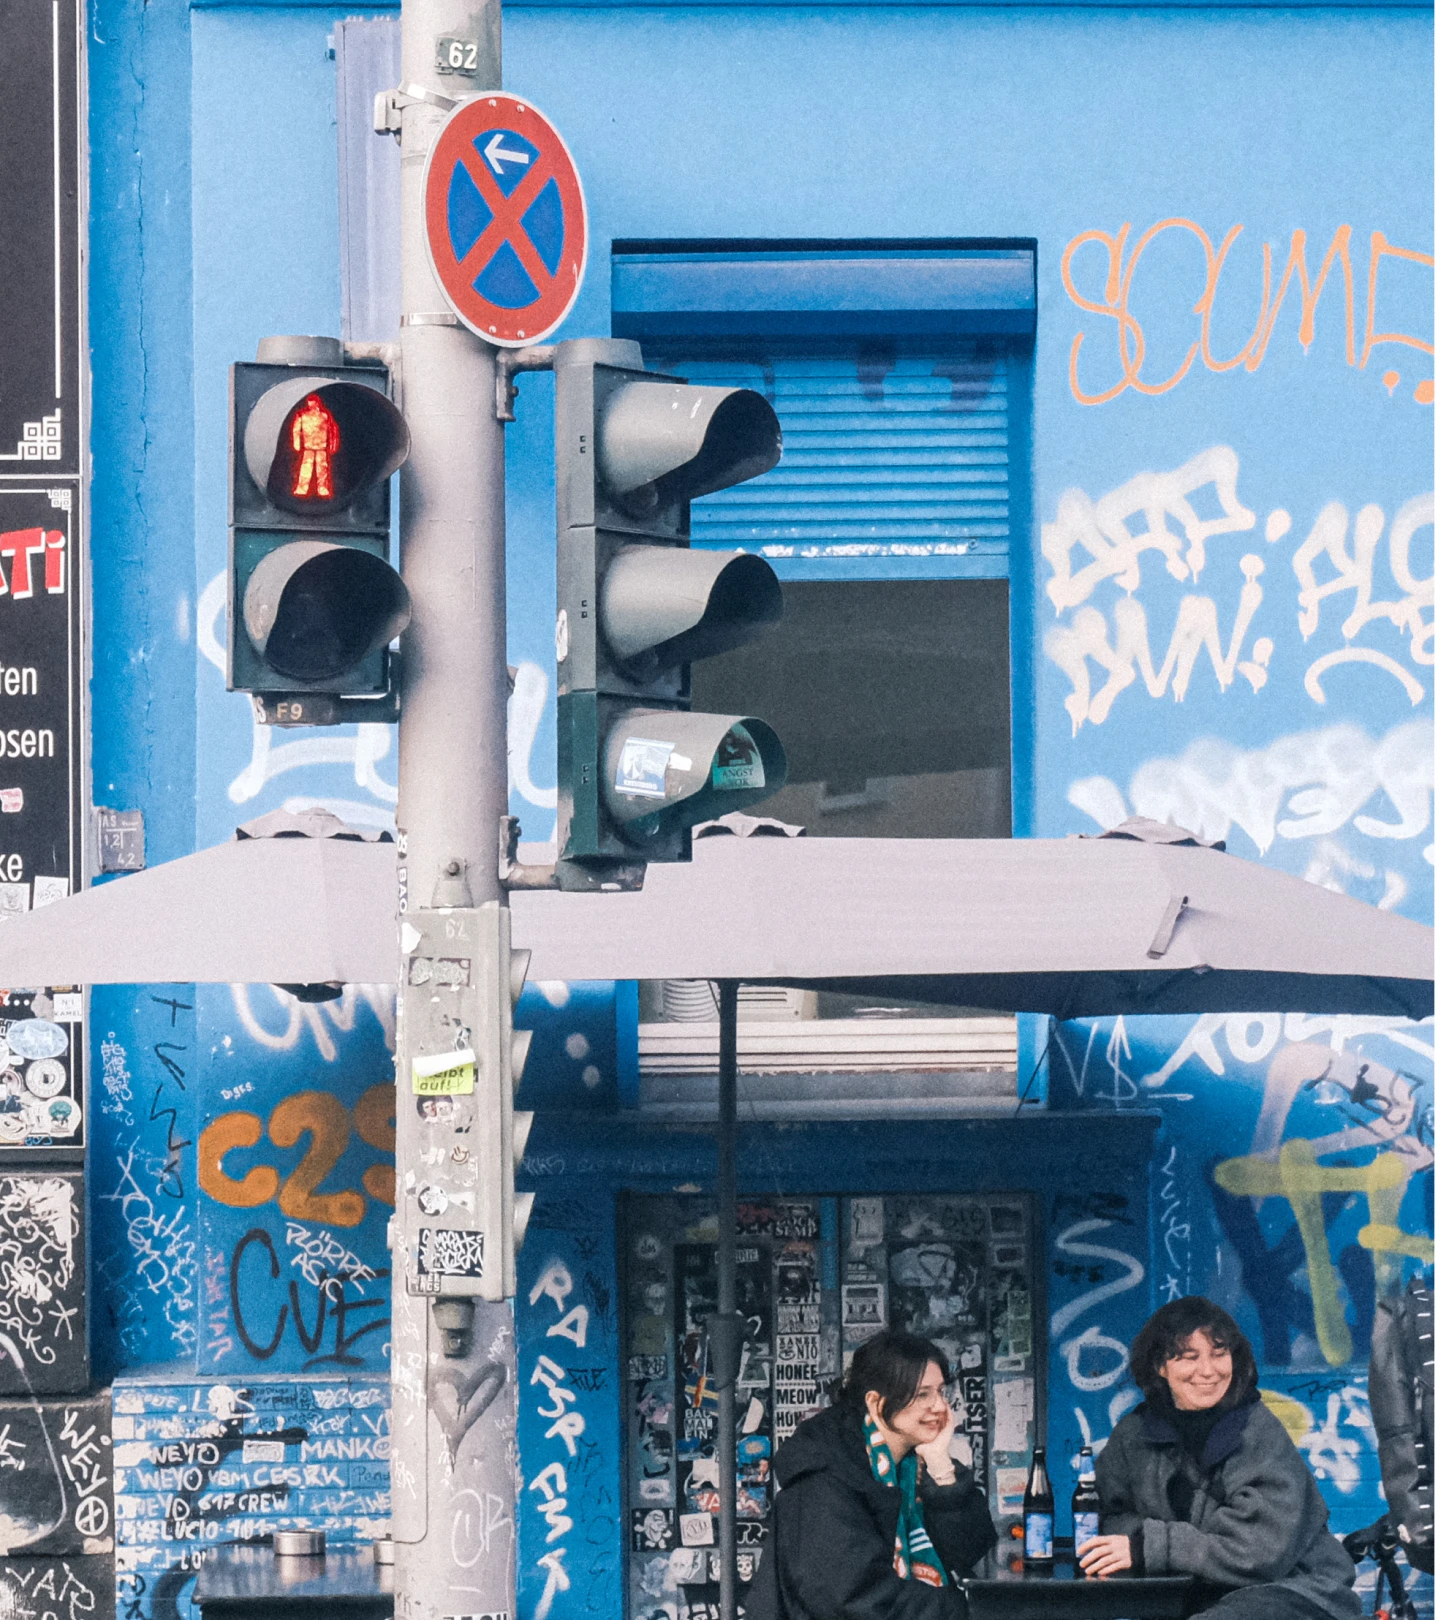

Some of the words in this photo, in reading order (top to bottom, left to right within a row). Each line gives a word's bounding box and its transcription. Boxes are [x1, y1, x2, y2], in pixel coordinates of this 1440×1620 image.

[448, 42, 477, 70] 62
[276, 703, 303, 721] F9
[775, 1388, 818, 1405] MEOW
